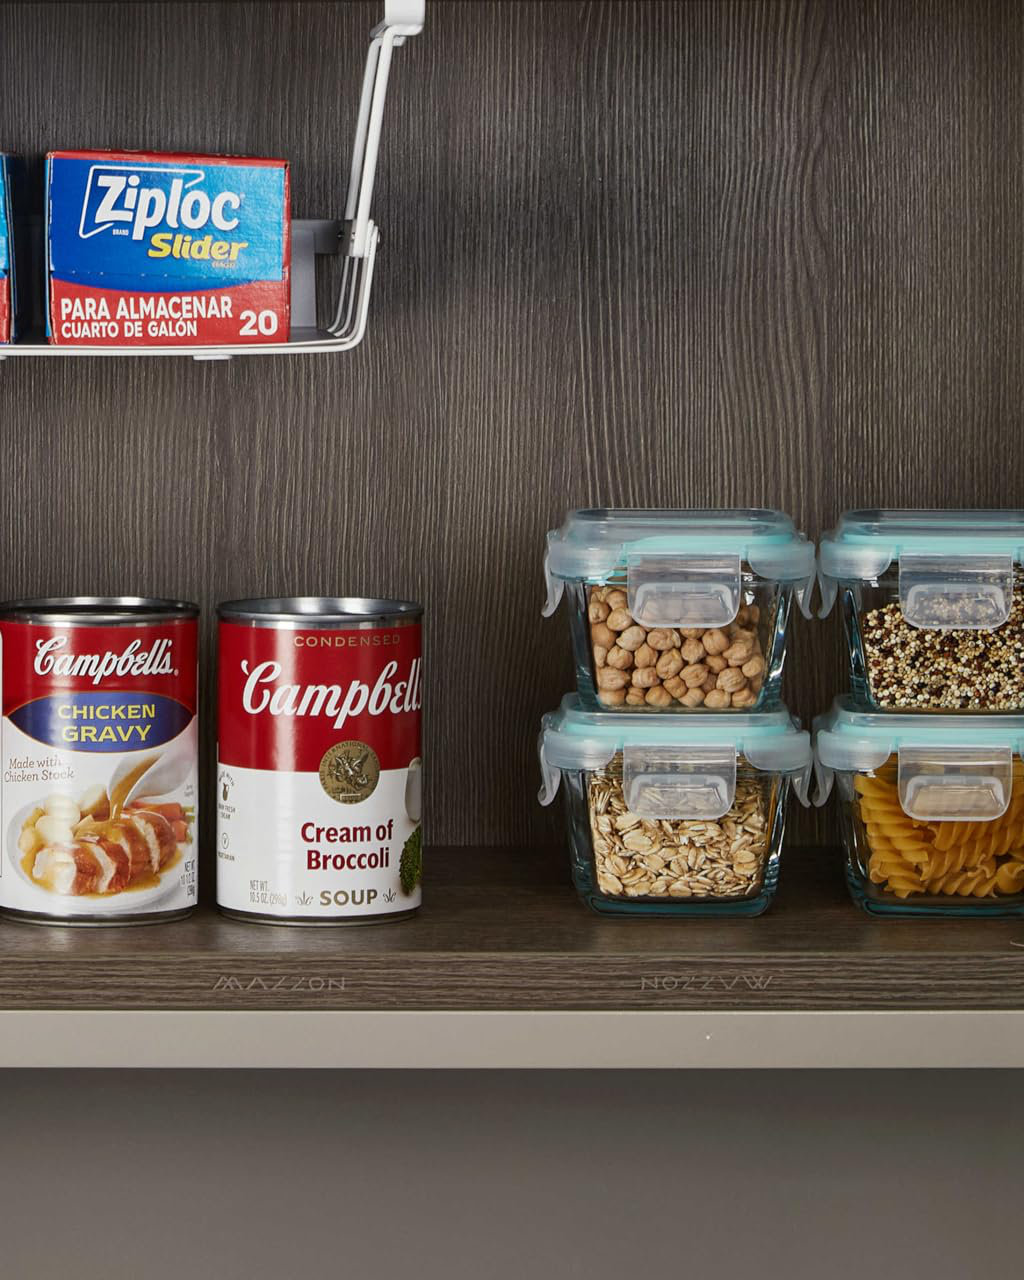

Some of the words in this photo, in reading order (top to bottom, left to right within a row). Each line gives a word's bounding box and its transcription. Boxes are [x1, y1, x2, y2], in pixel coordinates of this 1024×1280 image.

[94, 175, 241, 241] Ziploc
[147, 233, 249, 261] Slider
[61, 297, 111, 321] PARA
[116, 295, 233, 320] ALMACENAR
[61, 321, 119, 338] CUARTO
[124, 321, 143, 337] DE
[148, 317, 197, 337] GALÓN
[239, 310, 278, 337] 20
[294, 634, 401, 648] CONDENSED
[33, 635, 173, 685] Campbell's
[58, 703, 156, 720] CHICKEN
[62, 725, 152, 743] GRAVY
[9, 757, 35, 769] Made
[37, 754, 62, 768] with
[4, 770, 39, 783] Chicken
[41, 767, 75, 781] Stock
[300, 821, 372, 844] Cream
[376, 819, 394, 841] of
[306, 847, 391, 871] Broccoli
[319, 889, 378, 906] SOUP
